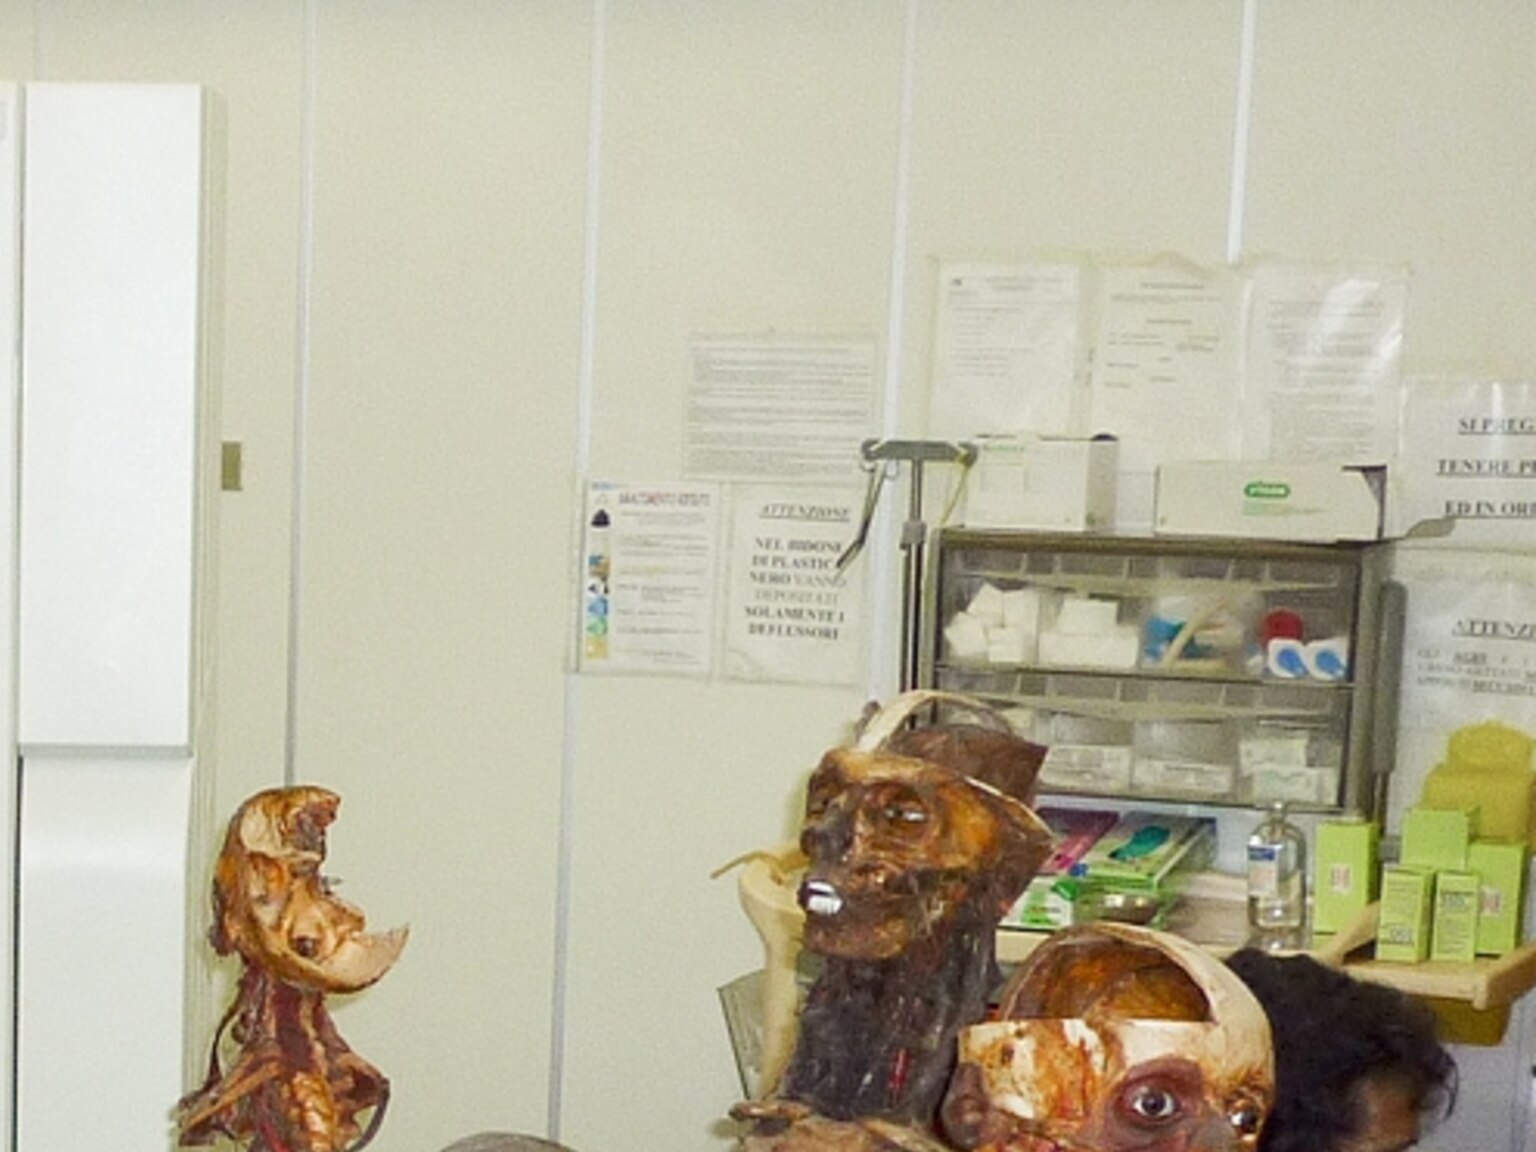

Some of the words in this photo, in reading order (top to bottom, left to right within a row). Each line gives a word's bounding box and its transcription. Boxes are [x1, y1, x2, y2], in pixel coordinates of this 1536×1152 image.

[761, 503, 850, 519] ATTENZIONE
[754, 536, 783, 550] NEL
[771, 555, 837, 570] PLASTIC
